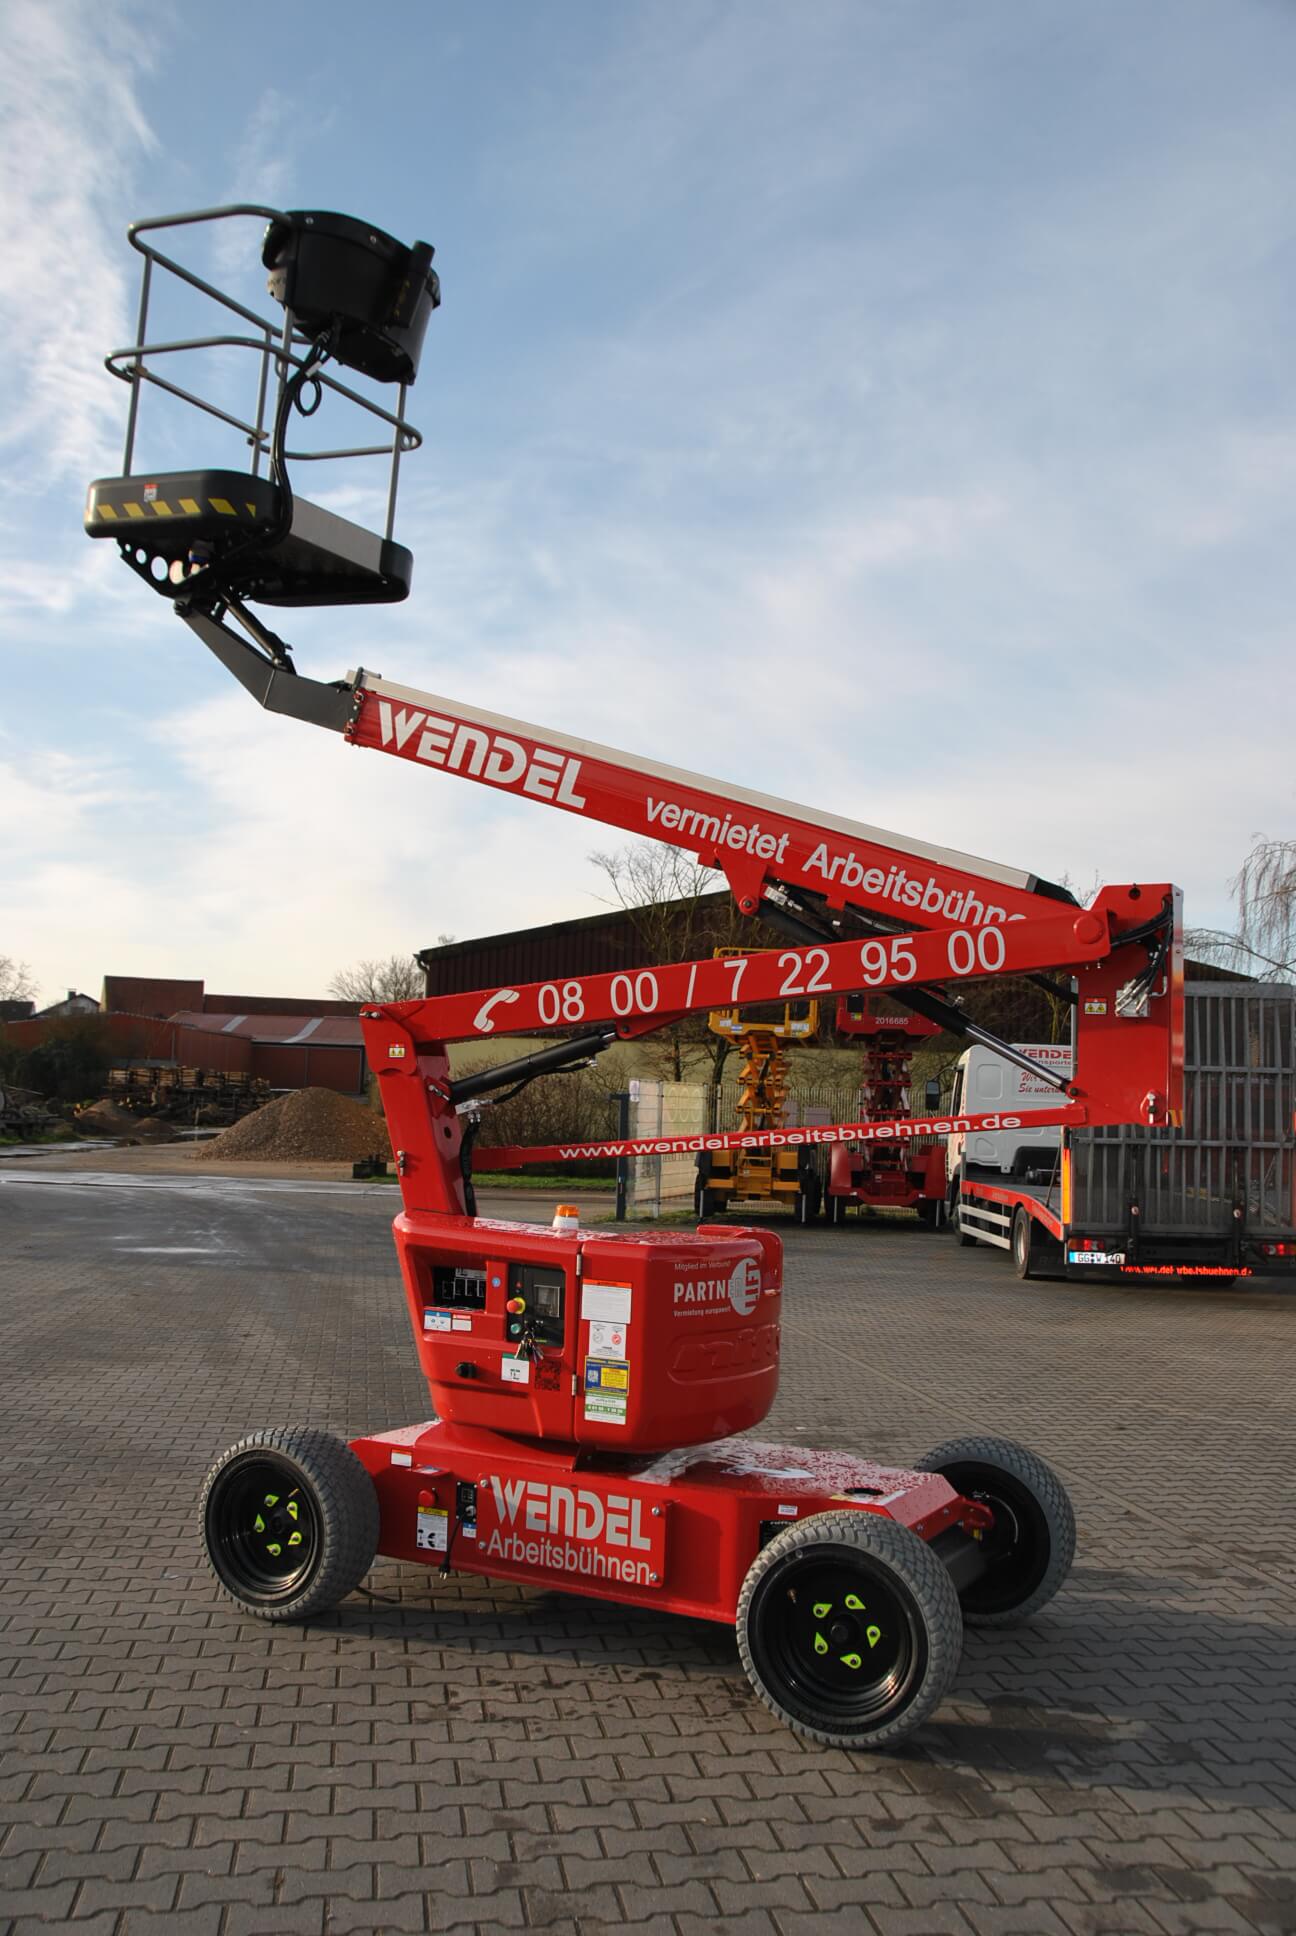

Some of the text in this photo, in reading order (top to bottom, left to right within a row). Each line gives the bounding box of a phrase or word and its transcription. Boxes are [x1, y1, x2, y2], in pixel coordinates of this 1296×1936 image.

[378, 700, 1026, 926] WENDEL vermietet Arbeitsbühn
[538, 981, 585, 1025] 08
[610, 971, 659, 1016] 00
[723, 959, 748, 1001] 7
[778, 949, 832, 996] 22
[860, 937, 917, 985] 95
[947, 926, 1006, 974] 00
[559, 1114, 1021, 1159] www.wendel-arbeitsbuehnen.de
[490, 1475, 651, 1551] WENDEL
[487, 1528, 651, 1586] Arbeitsbühnen
